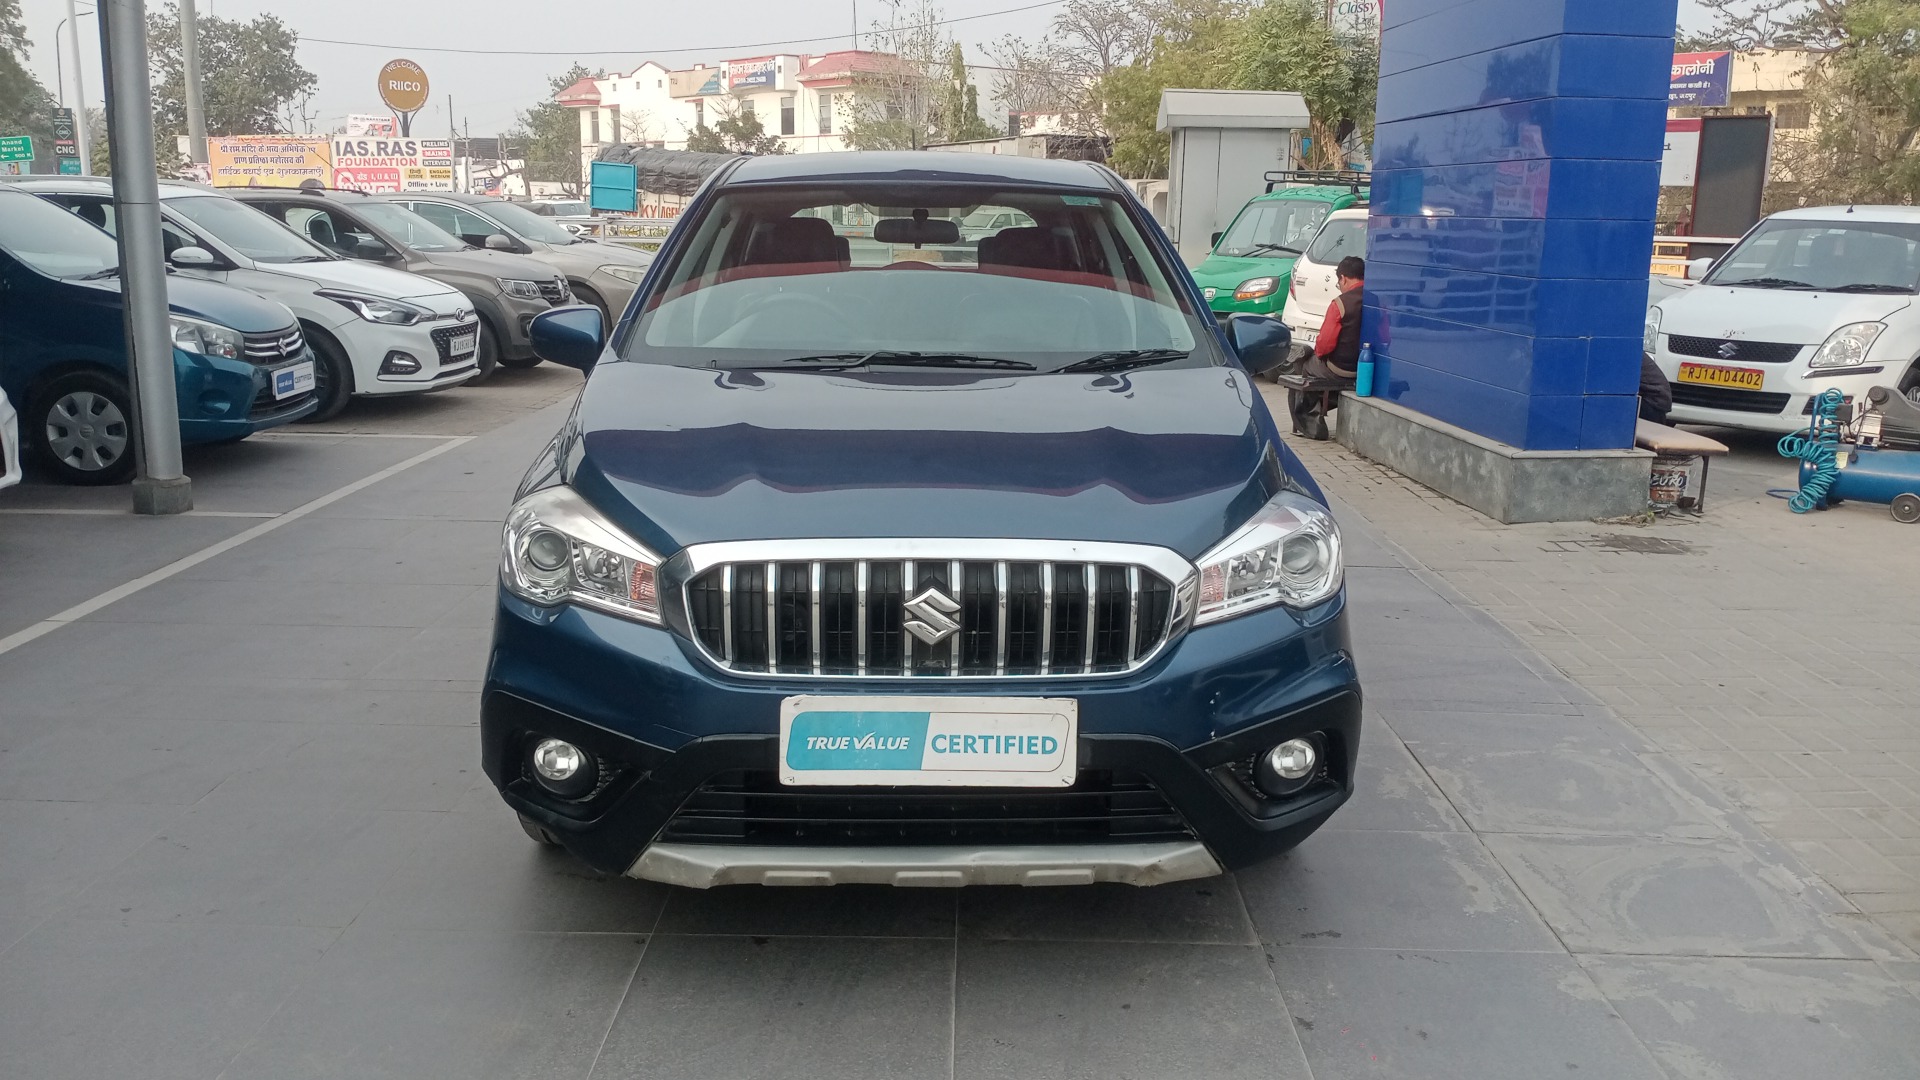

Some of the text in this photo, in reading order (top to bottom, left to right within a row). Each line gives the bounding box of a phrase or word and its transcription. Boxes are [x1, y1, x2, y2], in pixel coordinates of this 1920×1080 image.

[1338, 2, 1377, 15] Classy
[385, 61, 421, 76] WELCOME
[389, 80, 421, 92] RIICO
[56, 146, 75, 154] CNG
[229, 145, 240, 153] राम
[335, 141, 369, 157] IAS
[376, 141, 418, 157] RAS
[295, 155, 305, 164] की
[337, 157, 418, 167] FOUNDATION
[1687, 366, 1761, 386] RJ14TD4402
[1650, 472, 1684, 487] EURO
[806, 730, 1058, 755] TRUE VALUE CERTIFIED
